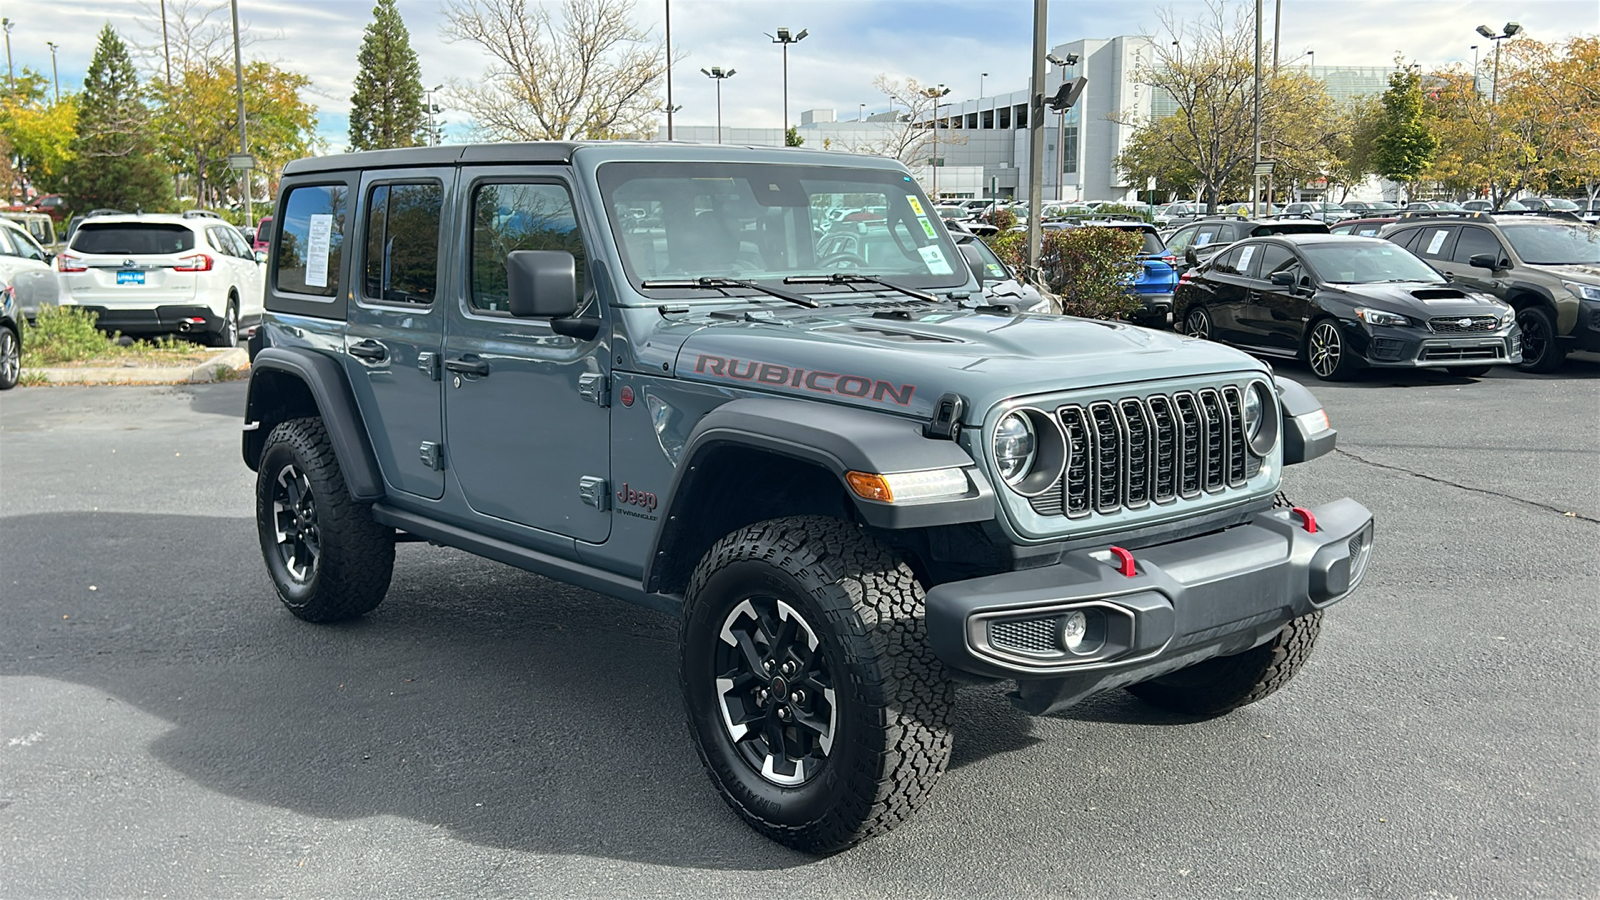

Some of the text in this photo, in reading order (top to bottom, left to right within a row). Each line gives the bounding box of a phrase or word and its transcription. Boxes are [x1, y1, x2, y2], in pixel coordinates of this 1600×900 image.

[694, 353, 917, 407] RUBICON
[616, 482, 658, 514] Jeep
[622, 509, 659, 521] WRANGLER
